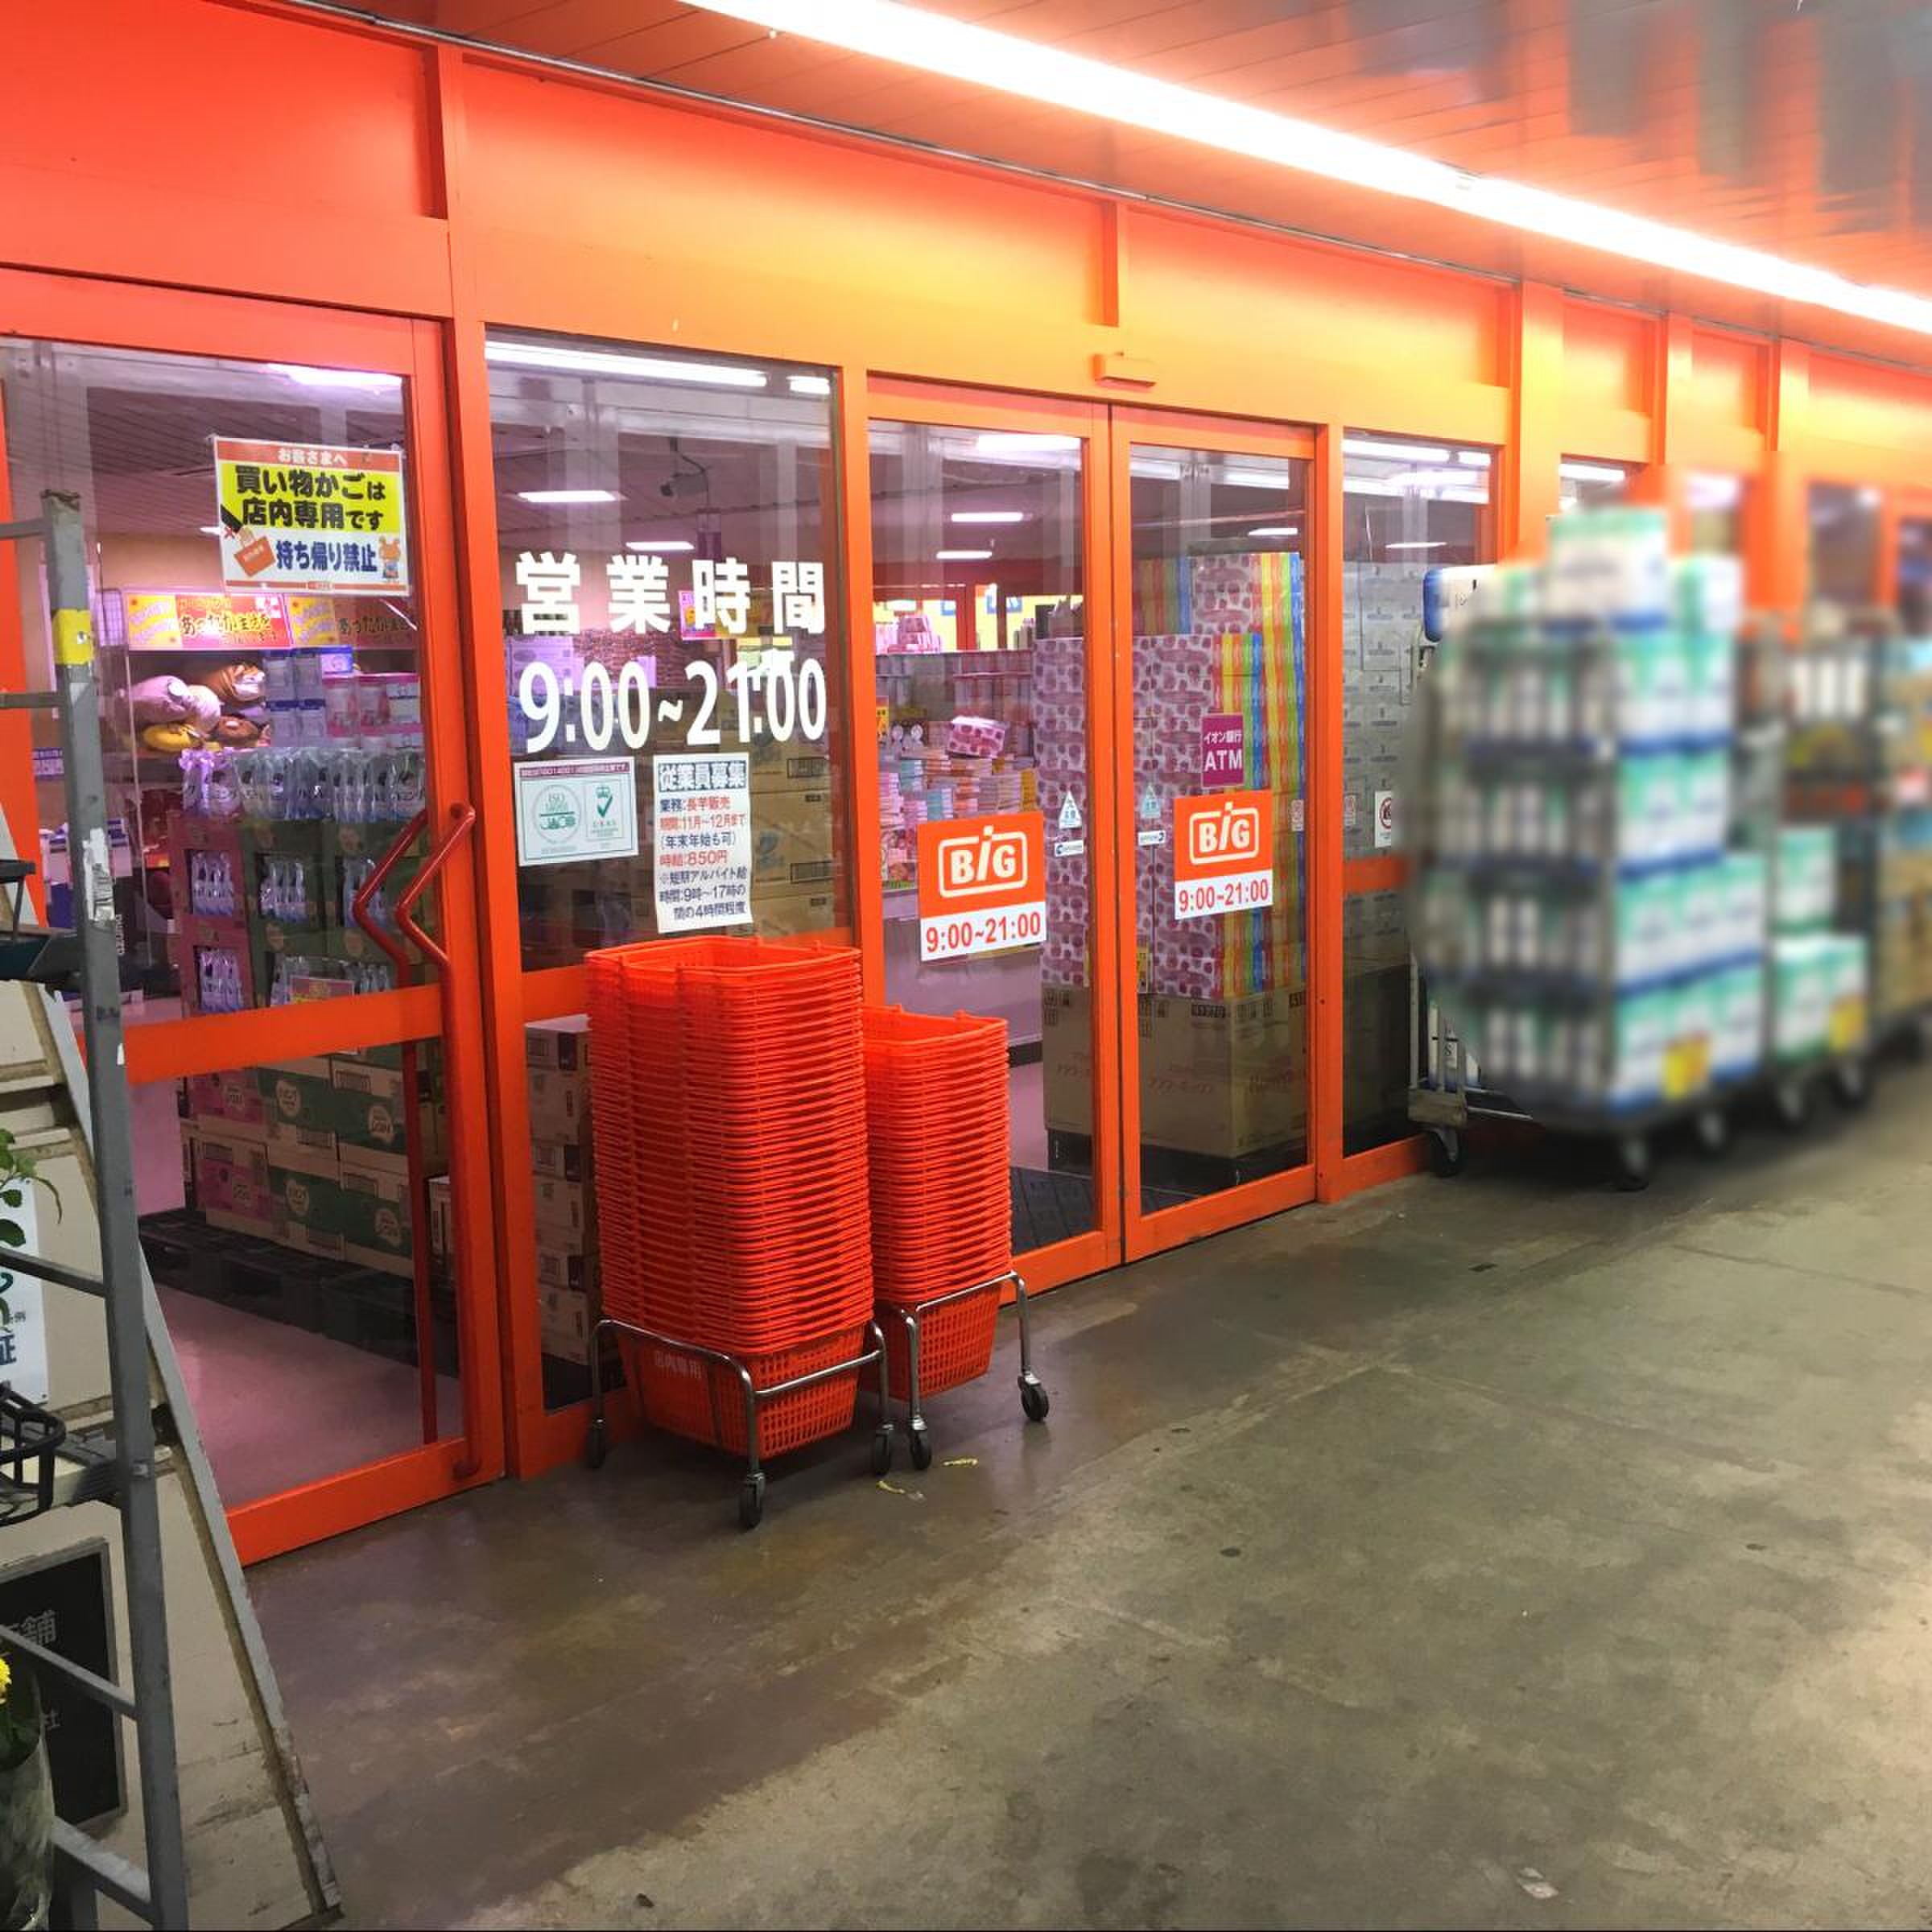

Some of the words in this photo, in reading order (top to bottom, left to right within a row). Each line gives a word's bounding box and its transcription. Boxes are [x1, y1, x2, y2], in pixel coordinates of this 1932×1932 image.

[235, 465, 386, 501] 買い物かごは
[242, 497, 384, 530] 店内専用です
[276, 540, 378, 572] 持ち帰り禁止
[516, 551, 825, 634] 営業時間
[658, 761, 747, 792] 従業員募集
[1204, 749, 1243, 772] ATM
